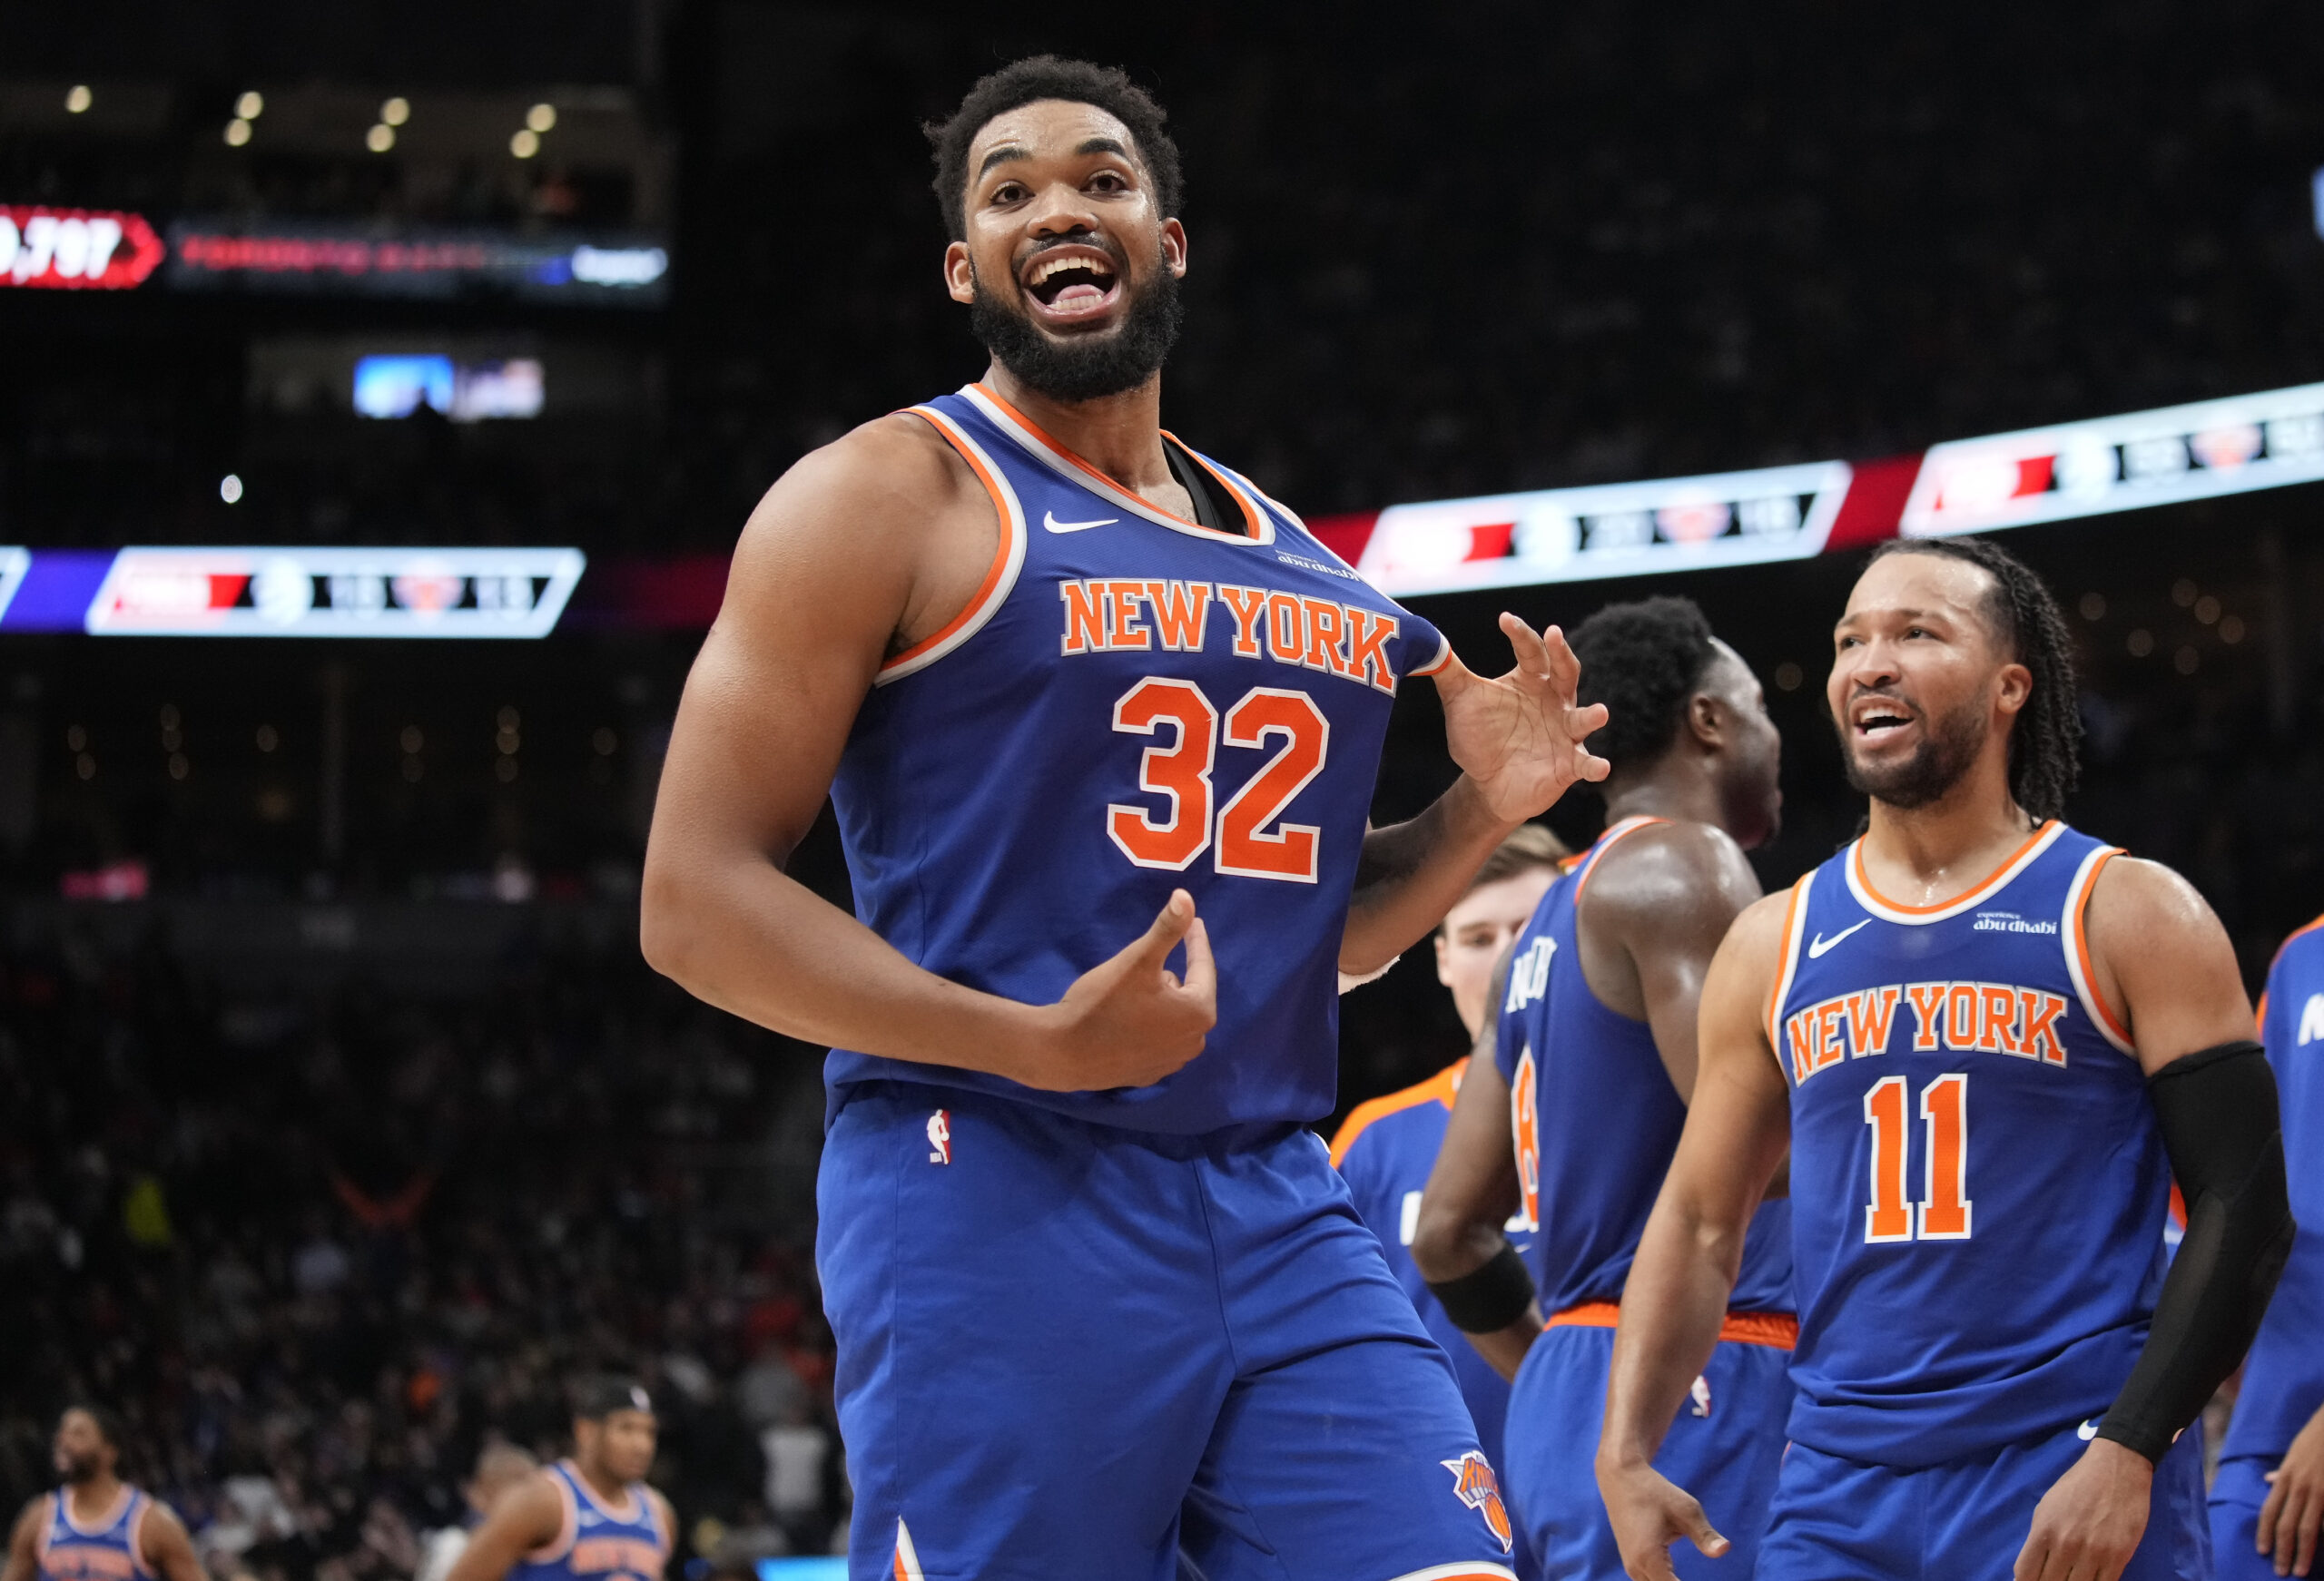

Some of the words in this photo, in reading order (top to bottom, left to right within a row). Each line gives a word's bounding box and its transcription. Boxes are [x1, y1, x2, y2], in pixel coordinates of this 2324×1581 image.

[1278, 555, 1310, 569] abu
[1059, 578, 1214, 656] NEW
[1215, 583, 1400, 698] YORK
[1107, 675, 1331, 884] 32
[1973, 918, 2007, 931] abu
[2008, 920, 2058, 935] dhabi
[1787, 984, 1904, 1087] NEW
[1905, 981, 2068, 1069] YORK
[1864, 1074, 1973, 1244] 11
